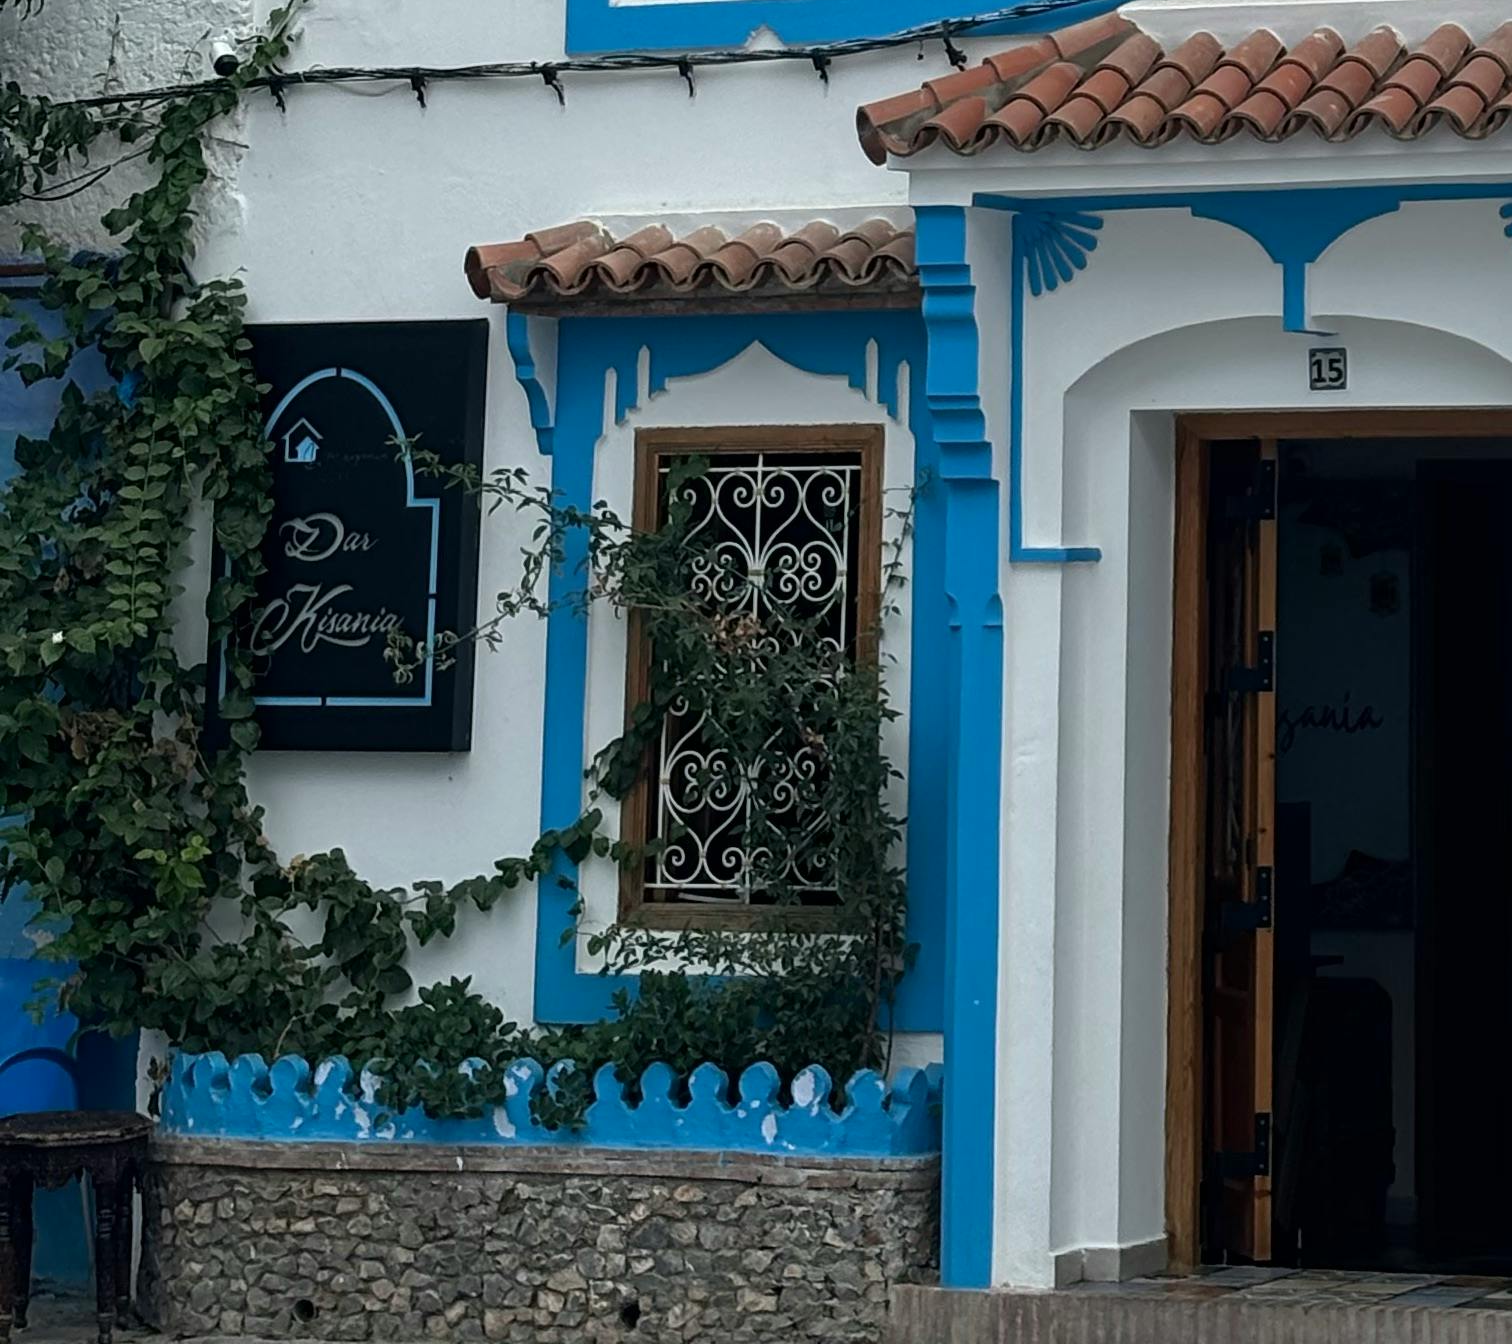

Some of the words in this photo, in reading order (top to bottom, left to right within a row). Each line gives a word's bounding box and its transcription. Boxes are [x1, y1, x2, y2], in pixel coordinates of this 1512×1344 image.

[1312, 358, 1344, 383] 15
[279, 512, 378, 562] Dar
[250, 583, 404, 656] Kisania
